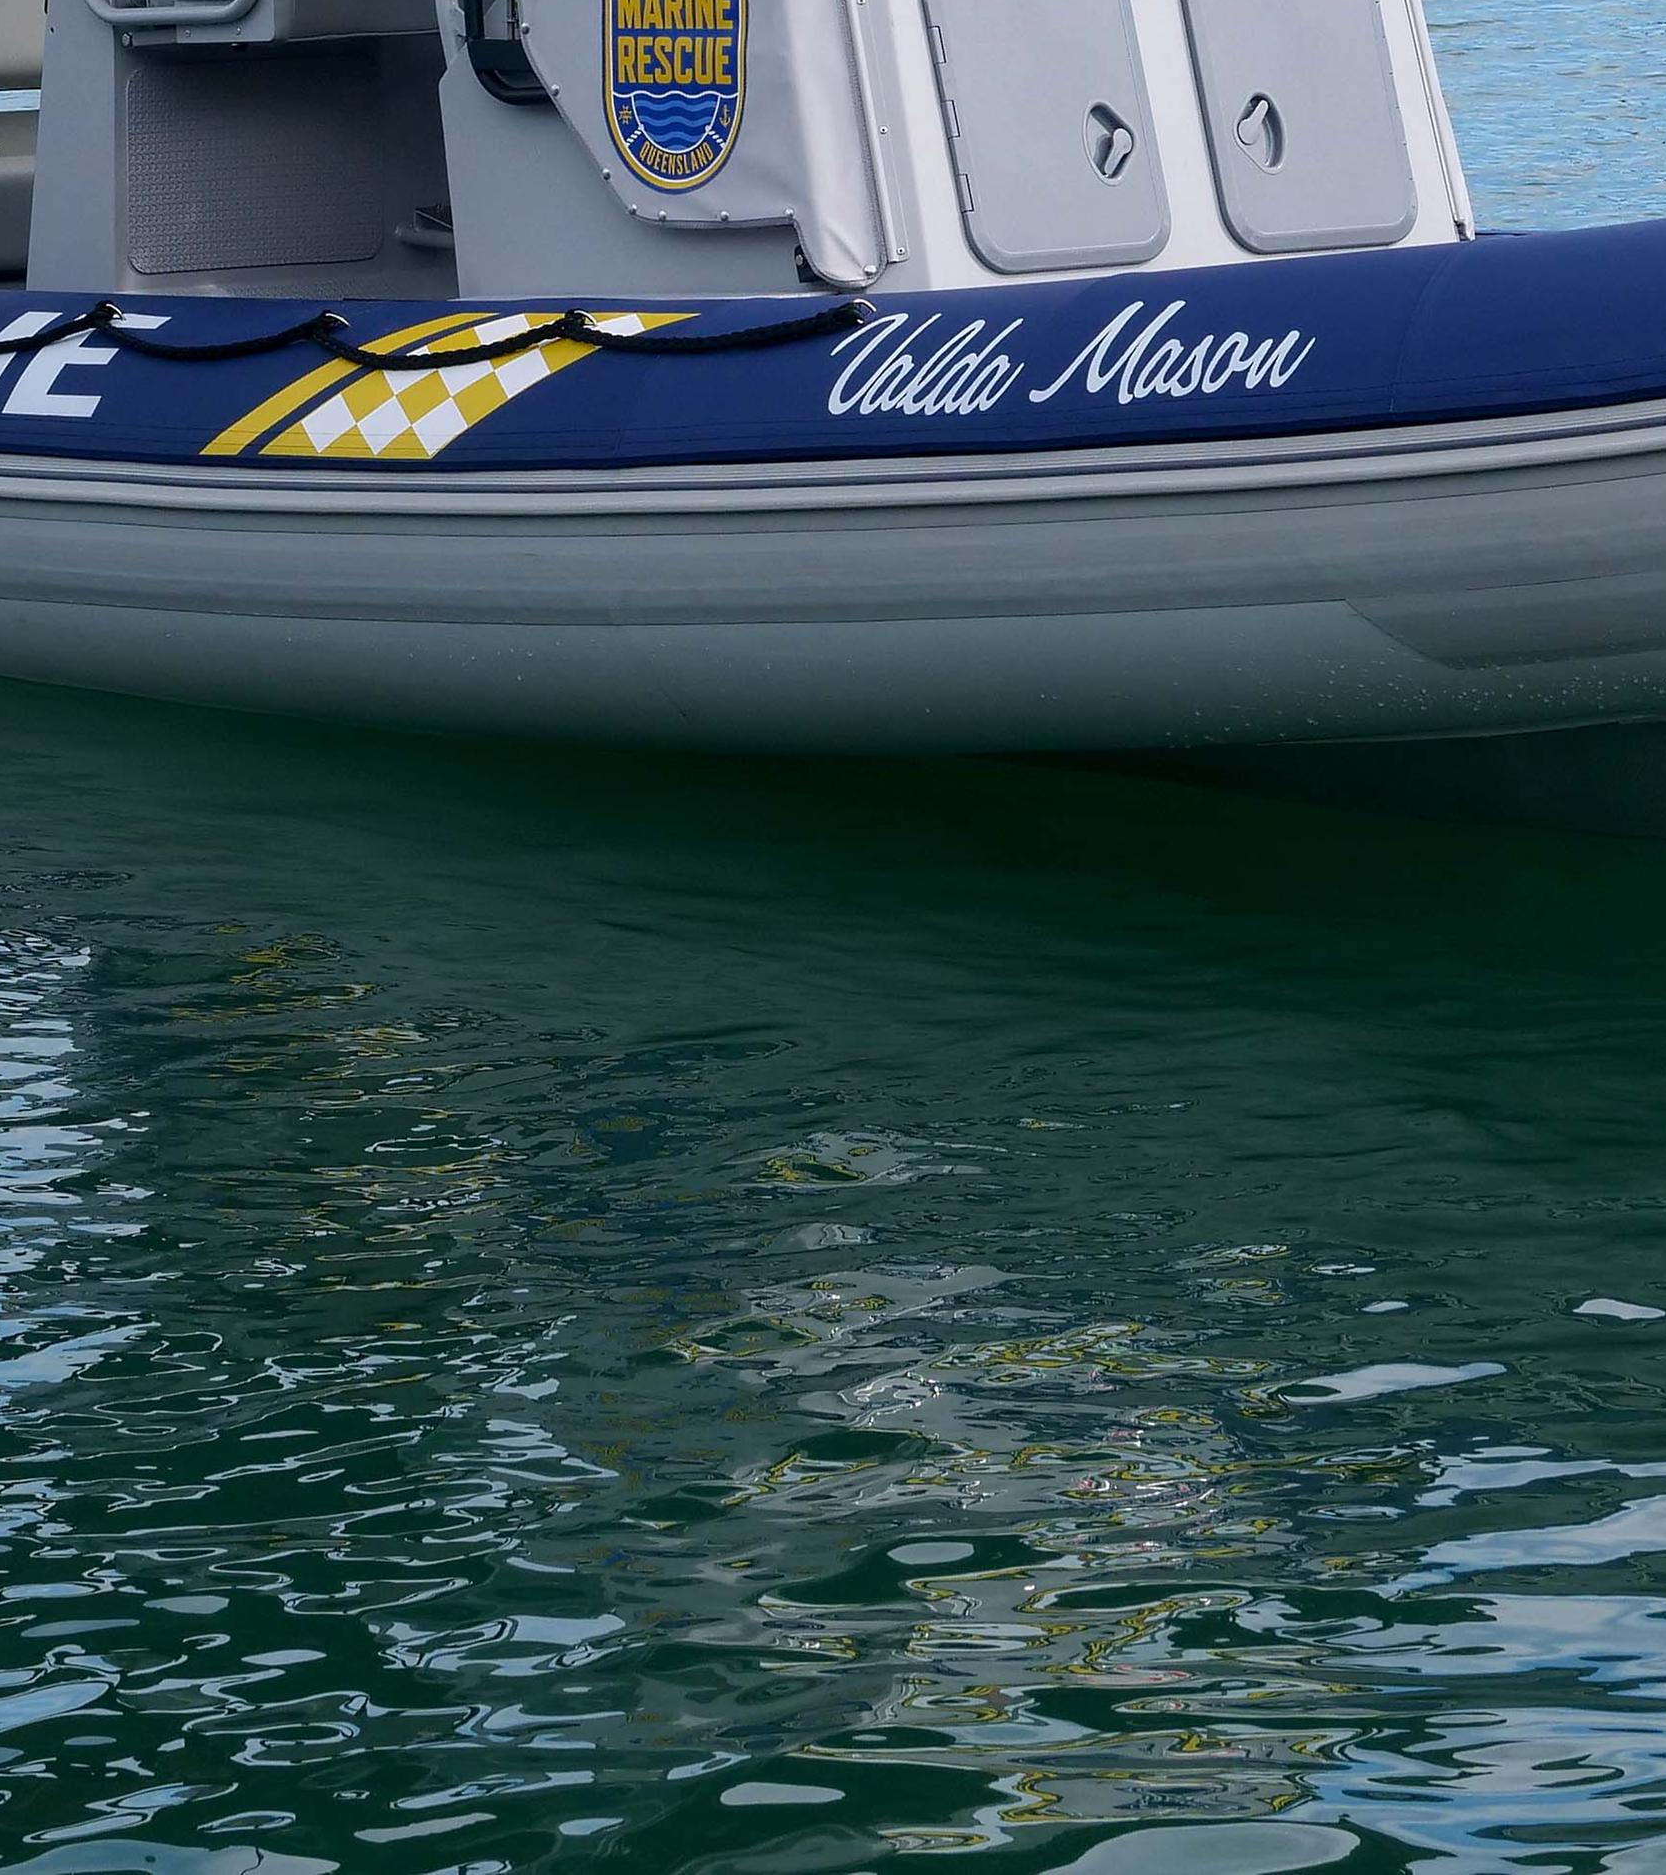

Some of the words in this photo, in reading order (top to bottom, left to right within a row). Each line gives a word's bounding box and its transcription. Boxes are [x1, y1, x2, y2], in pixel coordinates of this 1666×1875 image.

[616, 35, 733, 85] RESCUE
[639, 140, 715, 176] QUEENSLAND
[1028, 300, 1316, 405] Mason
